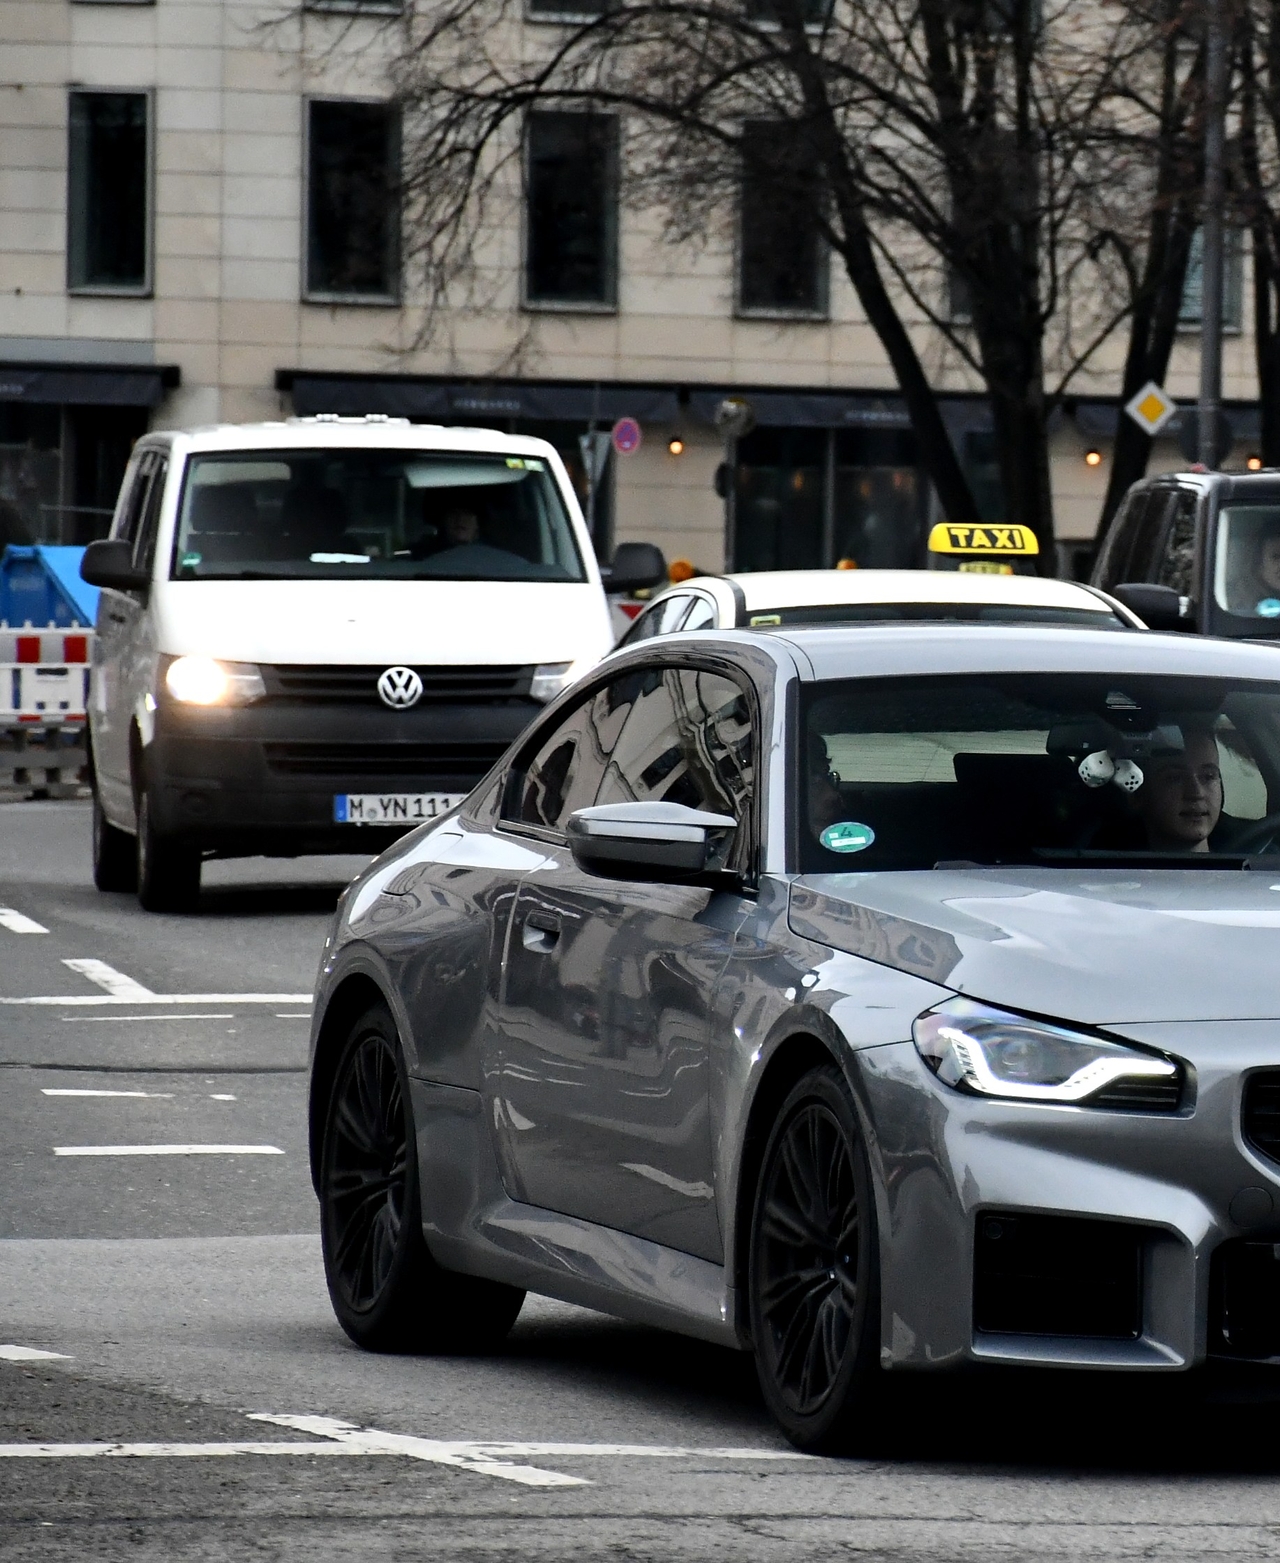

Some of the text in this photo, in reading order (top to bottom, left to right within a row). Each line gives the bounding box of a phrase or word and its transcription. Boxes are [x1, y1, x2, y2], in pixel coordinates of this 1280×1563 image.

[950, 528, 1023, 549] TAXI
[349, 797, 364, 818] M
[379, 797, 408, 818] YN
[840, 826, 853, 838] 4
